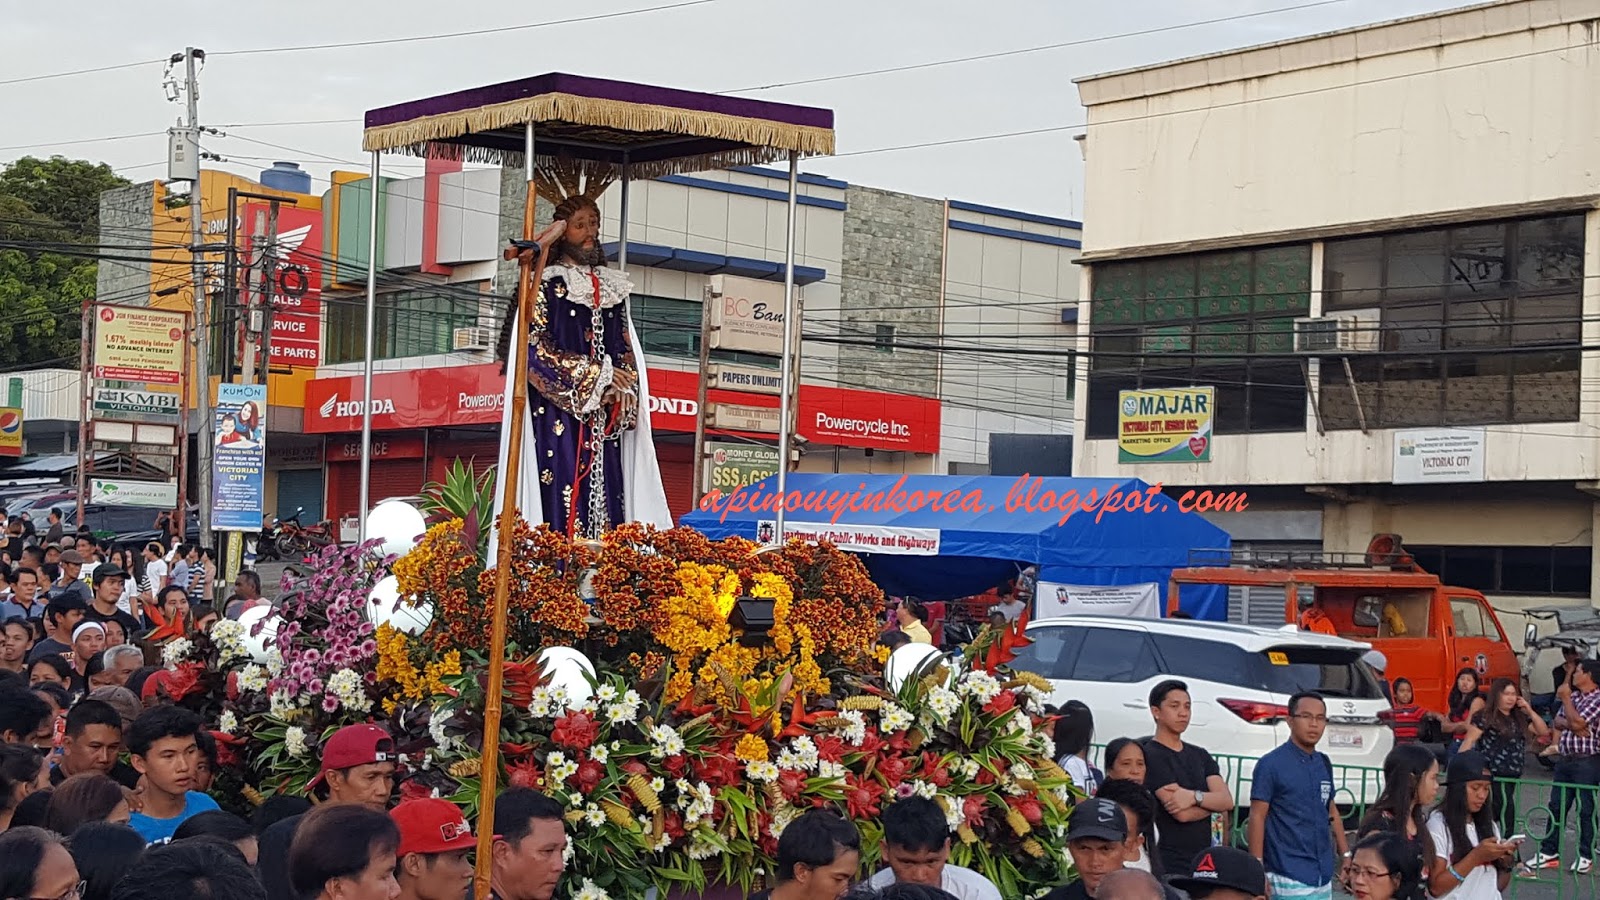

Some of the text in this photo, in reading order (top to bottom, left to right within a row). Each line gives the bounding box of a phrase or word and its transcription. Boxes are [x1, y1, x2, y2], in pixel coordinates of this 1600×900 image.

[273, 295, 302, 306] ALES
[724, 297, 785, 323] BC Ban
[148, 315, 182, 324] CORPORATION
[272, 320, 306, 332] RVICE
[105, 334, 126, 343] 1.67%
[283, 347, 317, 359] PARTS
[722, 372, 782, 388] PAPERS UNLIMIT
[223, 387, 261, 397] KUMON
[119, 392, 178, 407] KMBI
[458, 392, 504, 411] Powercyc
[648, 395, 698, 416] OND
[1140, 394, 1207, 415] MAJAR
[110, 403, 163, 413] VICTORIAS
[816, 412, 911, 436] Powercycle Inc.
[727, 449, 753, 457] MONEY
[755, 451, 779, 459] GLOBA
[1422, 456, 1471, 468] VICTORIAS CITY
[713, 466, 740, 487] SSS
[782, 531, 936, 551] epartment of Public Works and Highways
